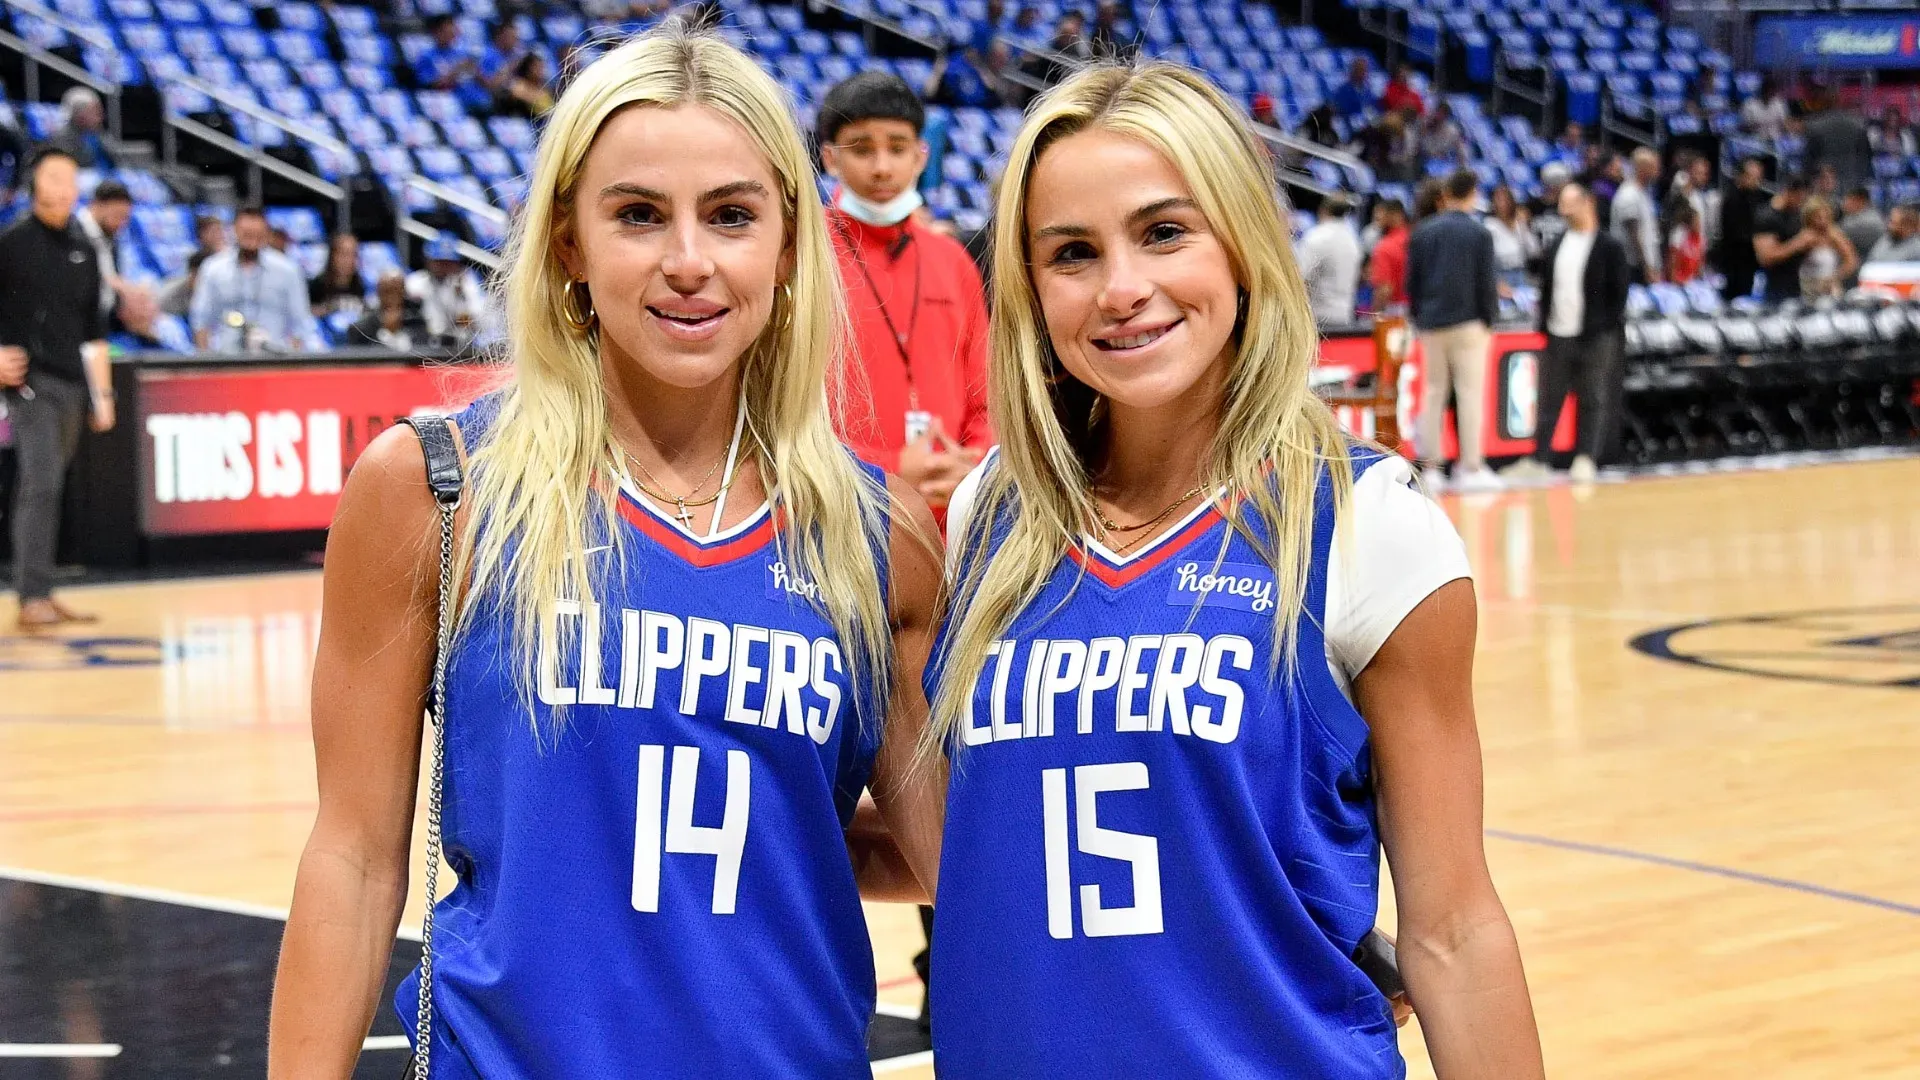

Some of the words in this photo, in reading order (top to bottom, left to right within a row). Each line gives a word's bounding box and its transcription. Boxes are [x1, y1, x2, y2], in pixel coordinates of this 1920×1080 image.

[146, 412, 254, 503] THIS
[257, 410, 304, 499] IS
[767, 561, 826, 603] hon
[1176, 562, 1274, 611] honey
[537, 598, 842, 744] CLIPPERS
[962, 633, 1254, 745] CLIPPERS
[631, 746, 751, 914] 14
[1042, 762, 1163, 939] 15
